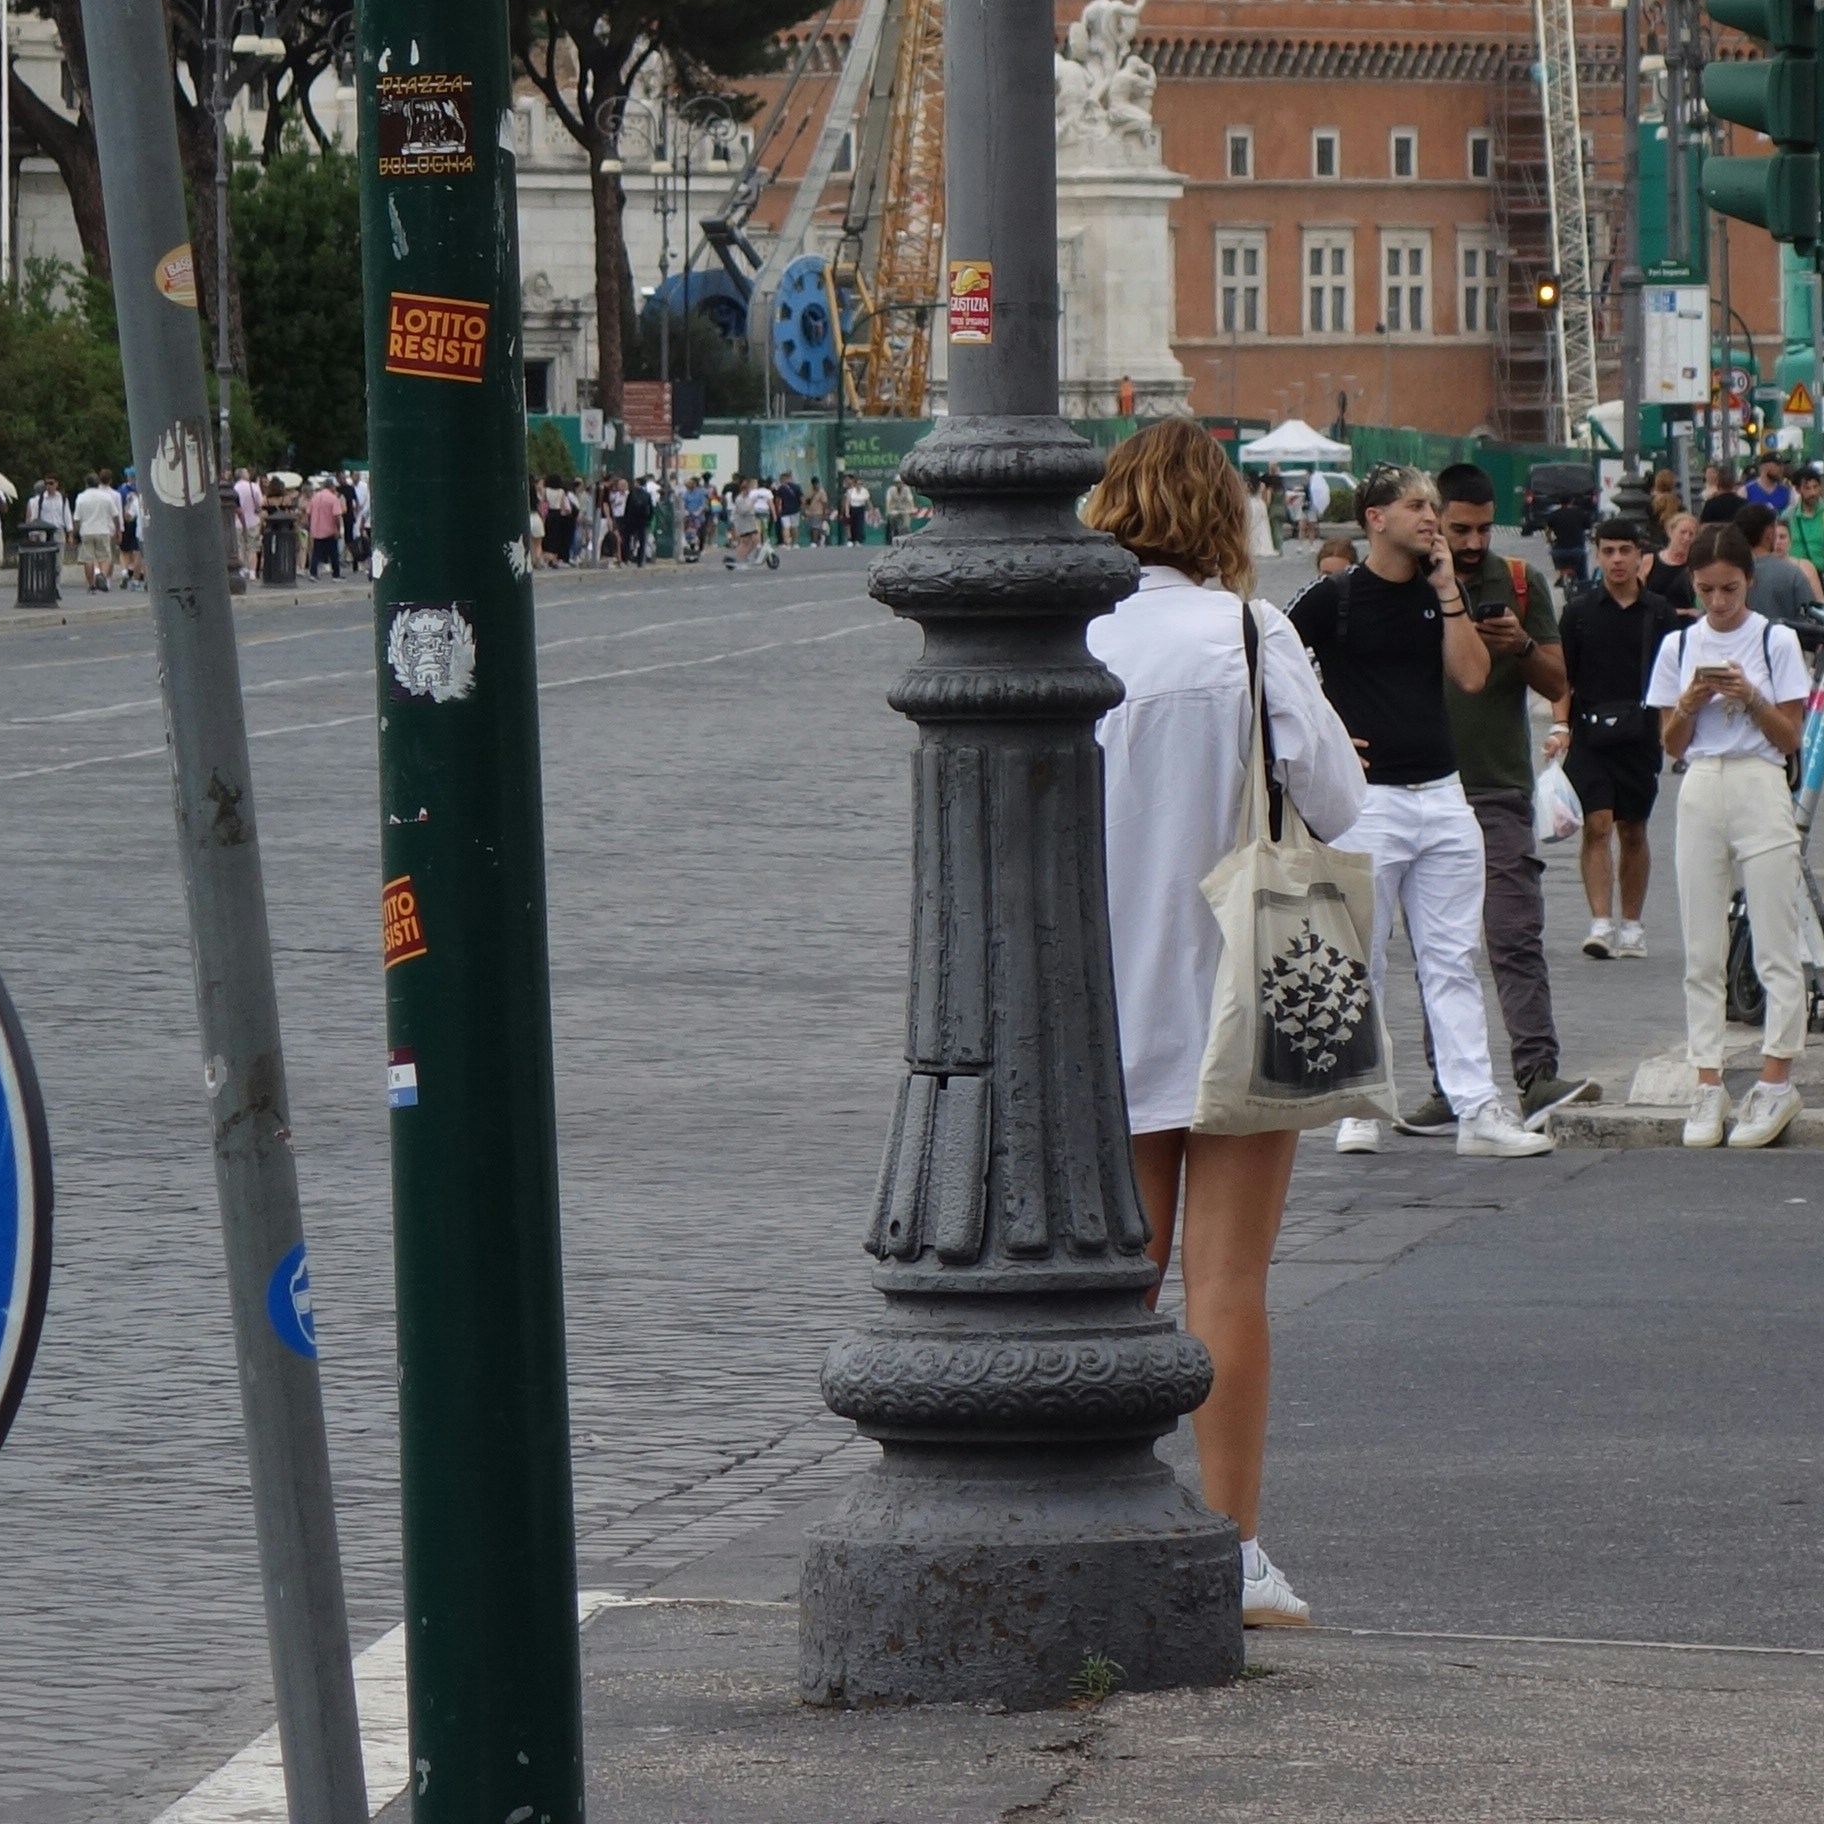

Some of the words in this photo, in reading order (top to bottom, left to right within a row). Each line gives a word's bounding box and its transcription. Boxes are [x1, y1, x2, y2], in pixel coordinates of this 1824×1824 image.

[382, 75, 463, 94] PIAZZA
[391, 306, 486, 340] LOTITO
[389, 333, 482, 367] RESISTI
[845, 453, 902, 467] onnects
